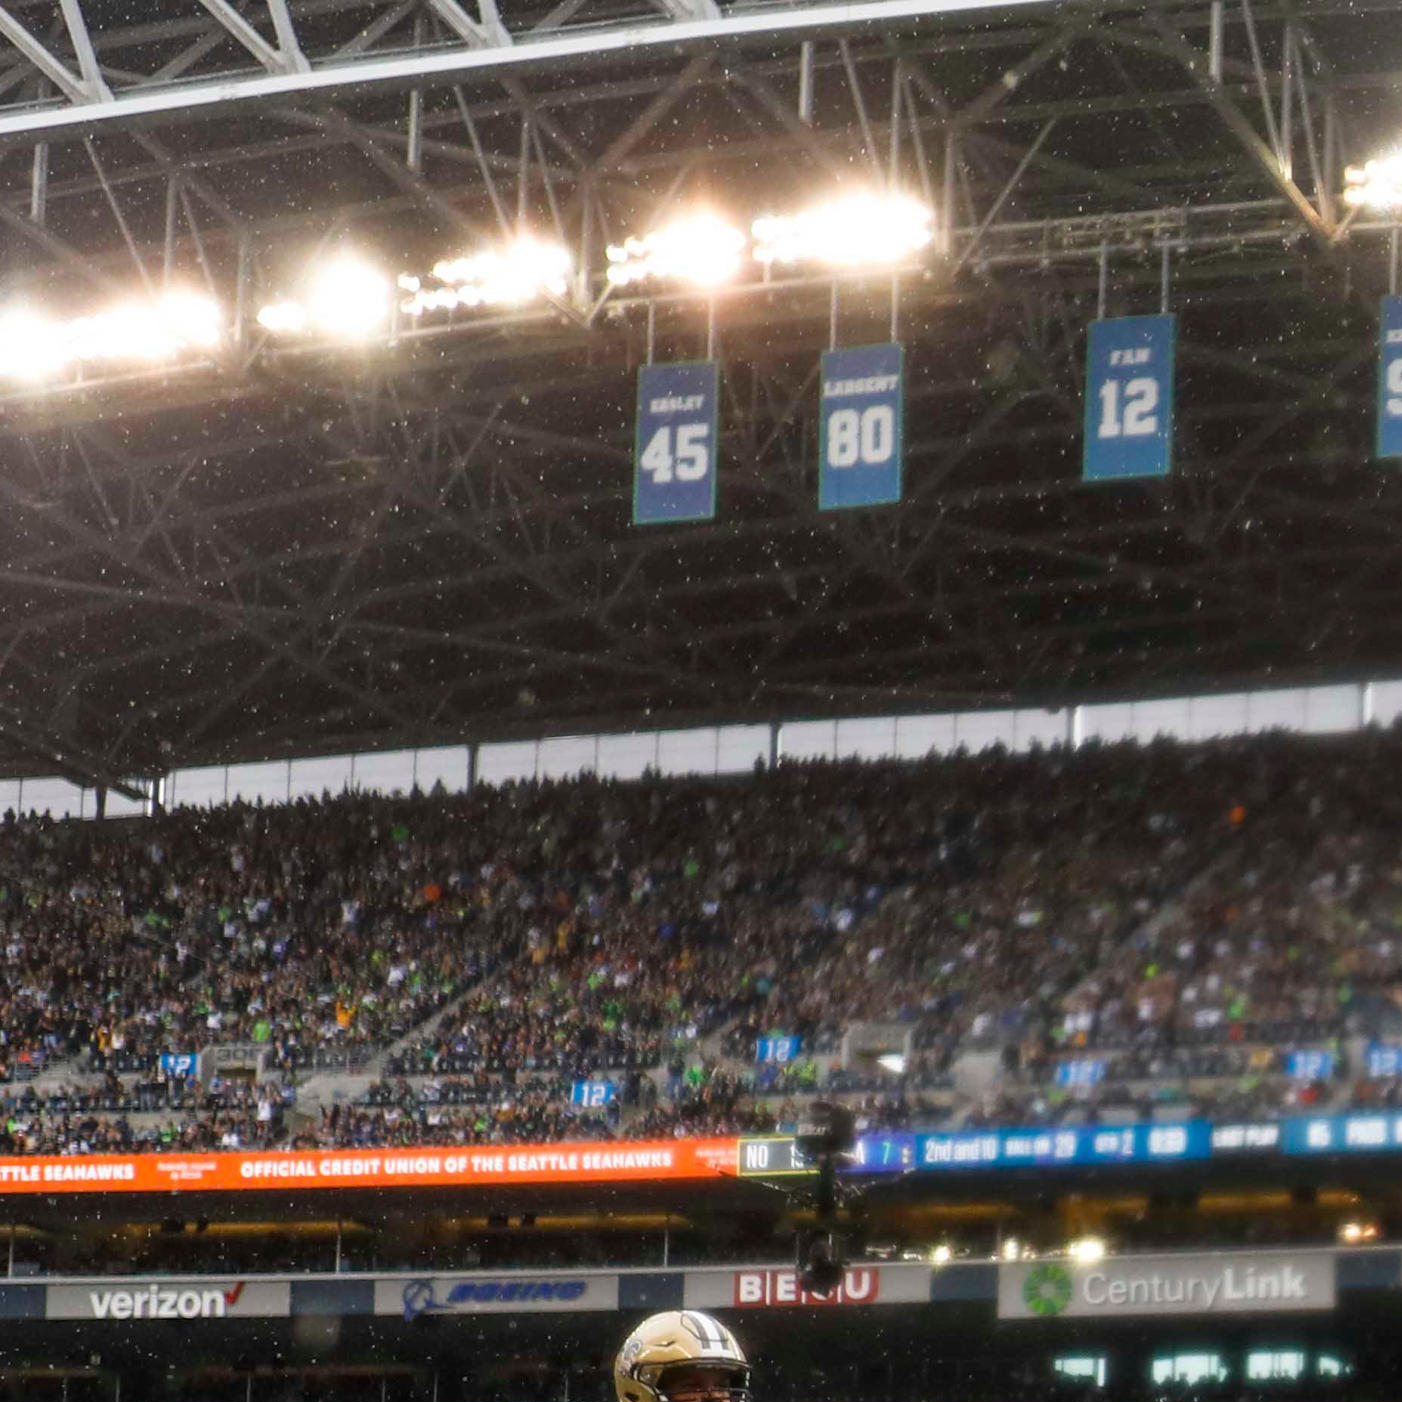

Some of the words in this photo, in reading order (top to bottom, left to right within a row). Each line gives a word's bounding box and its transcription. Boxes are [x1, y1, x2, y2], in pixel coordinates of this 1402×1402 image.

[1109, 348, 1150, 366] FAN
[823, 374, 899, 398] LARGENT
[1098, 376, 1159, 440] 12
[827, 404, 894, 468] 80
[640, 422, 709, 484] 45
[241, 1157, 316, 1179] OFFICIAL
[319, 1155, 380, 1176] CREDIT
[384, 1155, 441, 1175] UNION
[444, 1154, 469, 1174] OF
[471, 1154, 504, 1173] THE
[508, 1151, 577, 1172] SEATTLE
[583, 1149, 673, 1171] SEAHAWKS
[746, 1145, 769, 1169] NO
[882, 1142, 891, 1166] 7
[925, 1138, 951, 1163] 2nd
[953, 1140, 979, 1162] and
[980, 1138, 996, 1161] 10
[43, 1163, 135, 1182] SEAHAWKS
[446, 1279, 588, 1304] BOEING
[738, 1271, 873, 1303] BEU
[1081, 1265, 1308, 1307] CenturyLink
[90, 1284, 227, 1319] verizon
